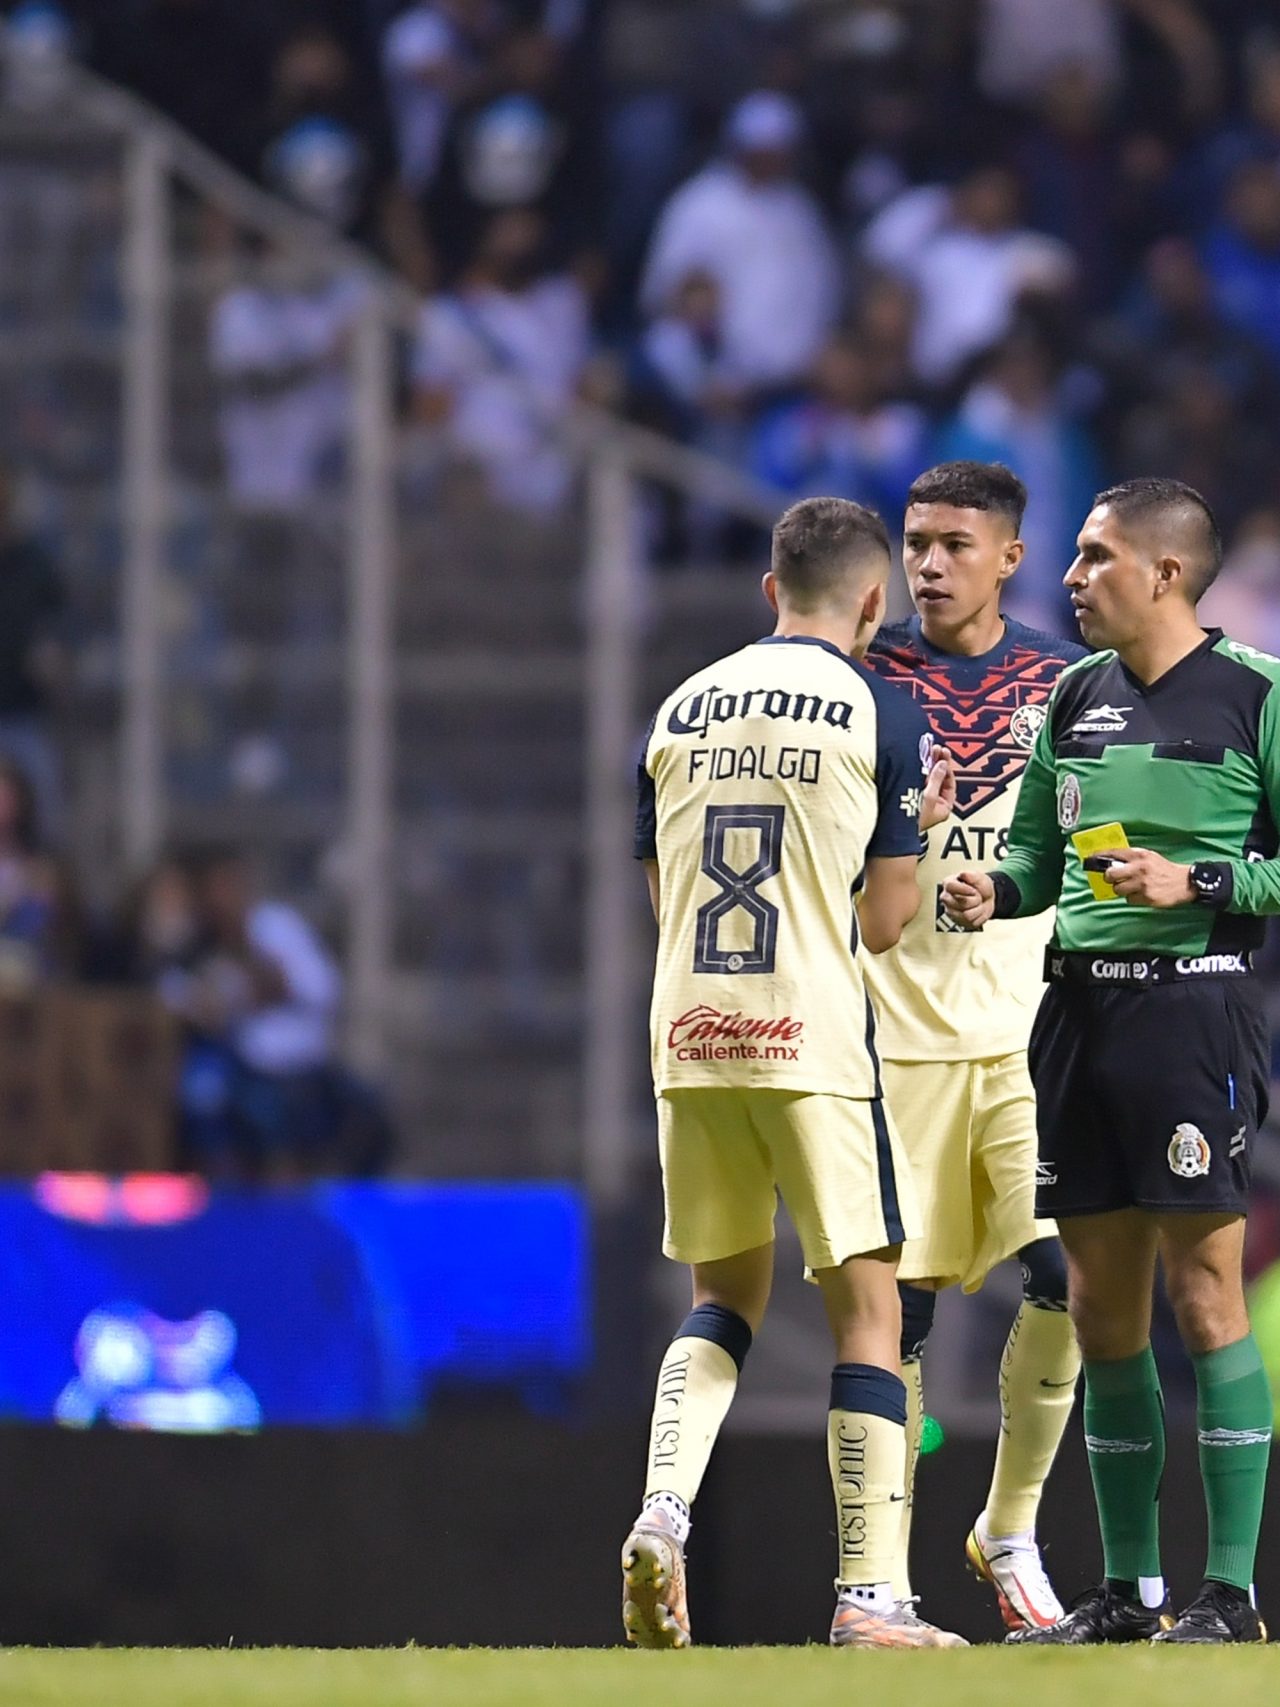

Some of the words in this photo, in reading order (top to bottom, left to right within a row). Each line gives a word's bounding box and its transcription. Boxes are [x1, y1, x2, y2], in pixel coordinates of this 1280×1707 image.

[667, 685, 851, 738] Corona
[688, 745, 821, 784] FIDALGO
[940, 825, 1008, 861] AT&
[692, 804, 785, 974] 8
[1174, 951, 1246, 975] Comex
[668, 1003, 804, 1049] Caliente
[676, 1042, 799, 1062] caliente.mx
